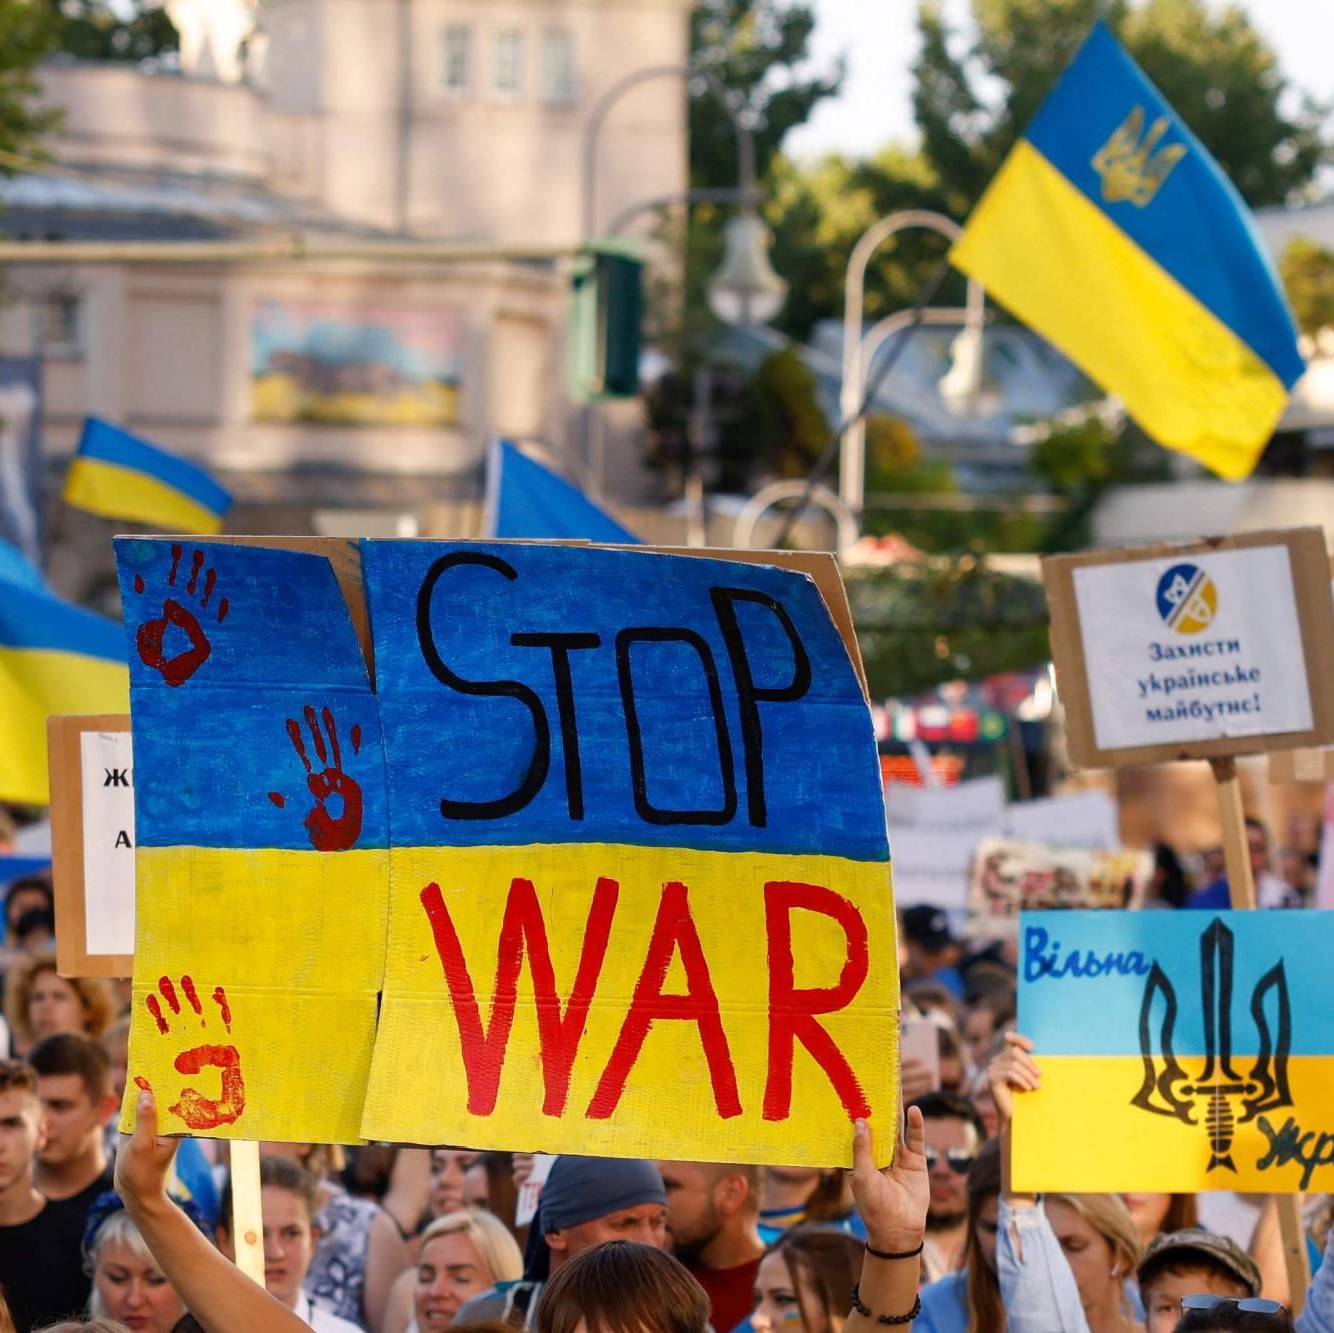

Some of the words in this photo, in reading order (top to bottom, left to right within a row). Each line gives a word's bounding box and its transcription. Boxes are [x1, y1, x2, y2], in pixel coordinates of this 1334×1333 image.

[1149, 638, 1241, 662] Захисти
[417, 550, 812, 828] STOP
[1138, 664, 1261, 698] українське
[1025, 926, 1150, 982] Вільна
[419, 878, 871, 1122] WAR
